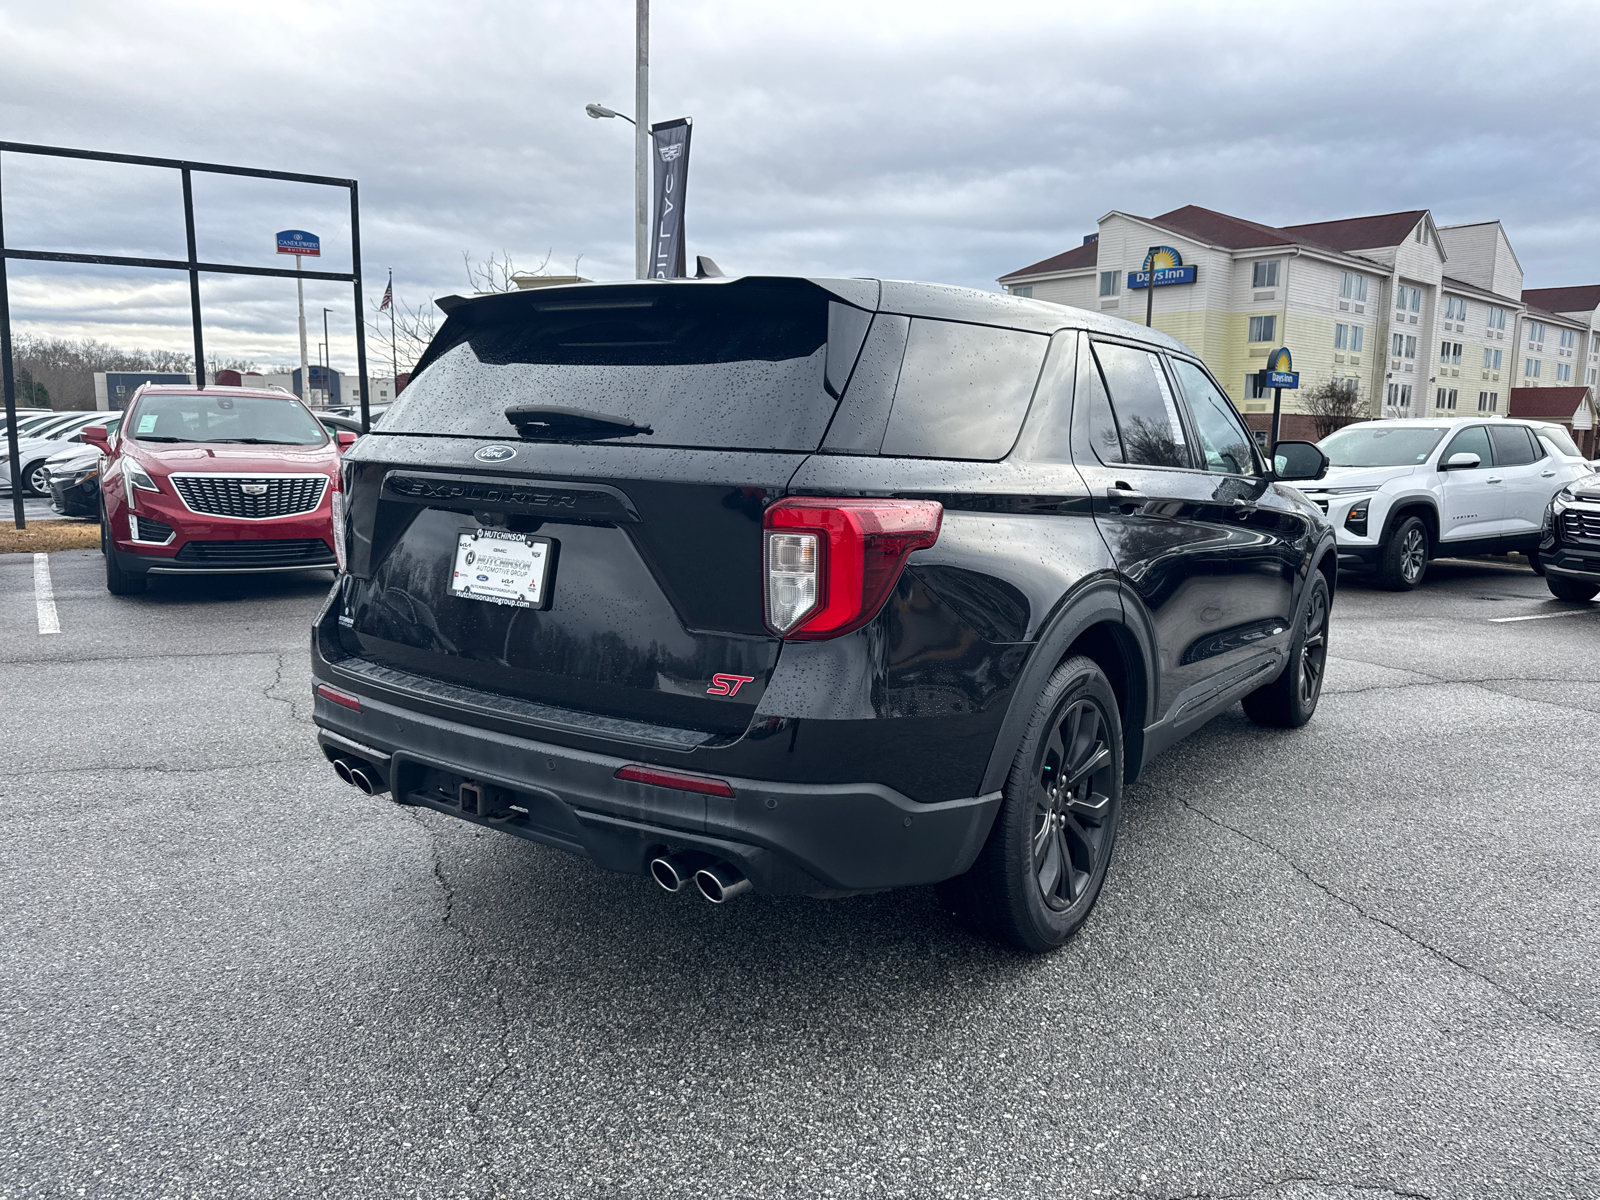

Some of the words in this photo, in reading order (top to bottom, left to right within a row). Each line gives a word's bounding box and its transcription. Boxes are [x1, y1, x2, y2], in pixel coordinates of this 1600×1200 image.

[1165, 270, 1184, 279] Inn
[1272, 373, 1284, 383] Days
[407, 483, 577, 509] EXPLORER
[484, 531, 526, 542] HUTCHINSON
[476, 555, 532, 571] HUTCHINSON
[476, 566, 509, 575] AUTOMOTIVE
[456, 590, 530, 607] Hutchinsonautogroup.com
[706, 672, 755, 697] ST
